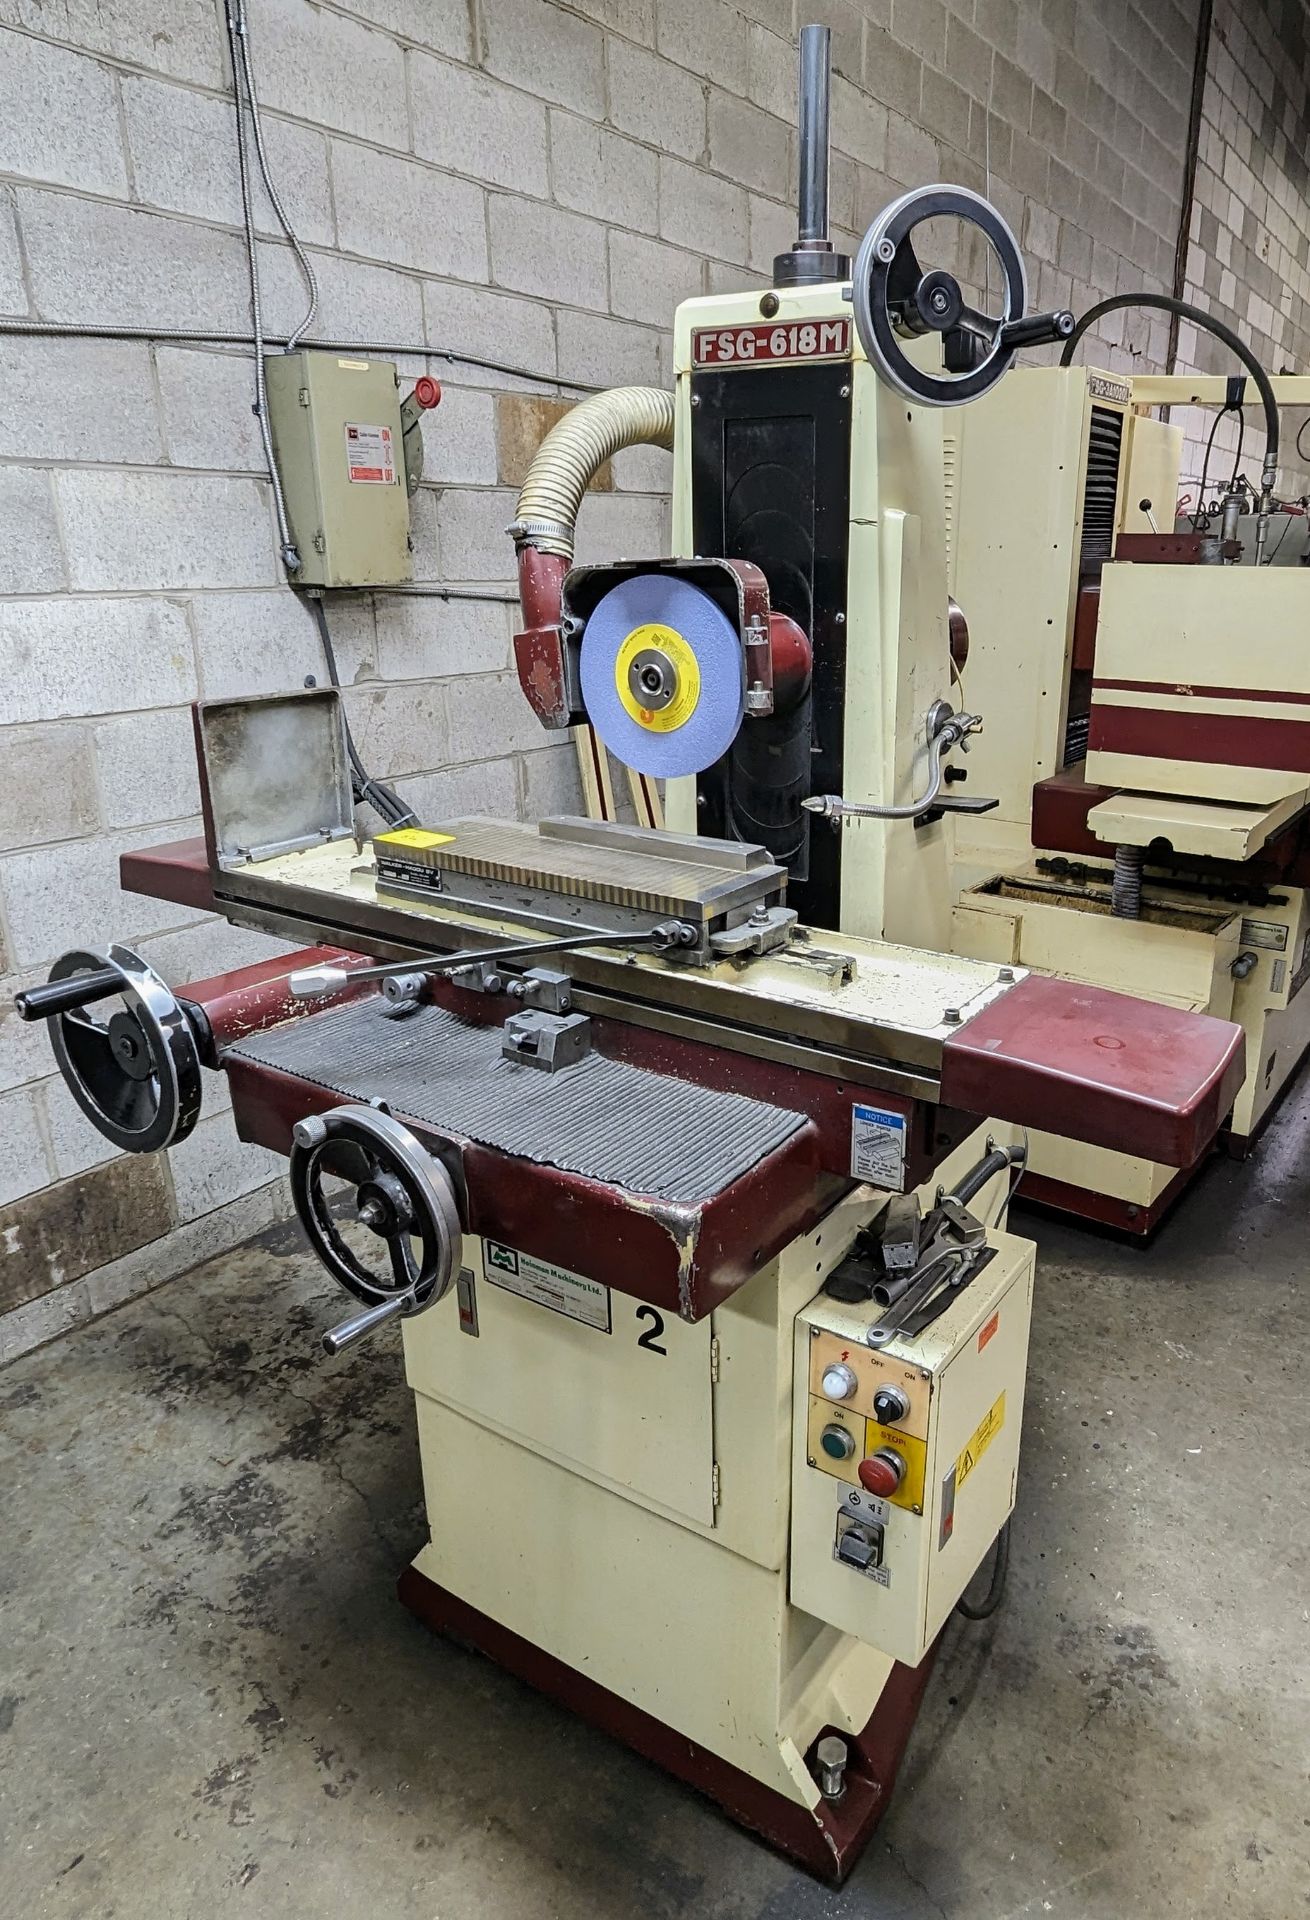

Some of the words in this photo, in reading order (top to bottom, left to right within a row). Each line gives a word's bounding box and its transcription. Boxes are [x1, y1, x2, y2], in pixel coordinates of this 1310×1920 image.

[700, 322, 843, 361] FSG-618M
[865, 1112, 894, 1124] NOTICE
[550, 1269, 587, 1291] Machinery
[587, 1284, 602, 1296] Ltd.
[636, 1304, 668, 1357] 2
[871, 1358, 885, 1368] OFF
[904, 1371, 916, 1381] ON
[834, 1410, 844, 1420] ON
